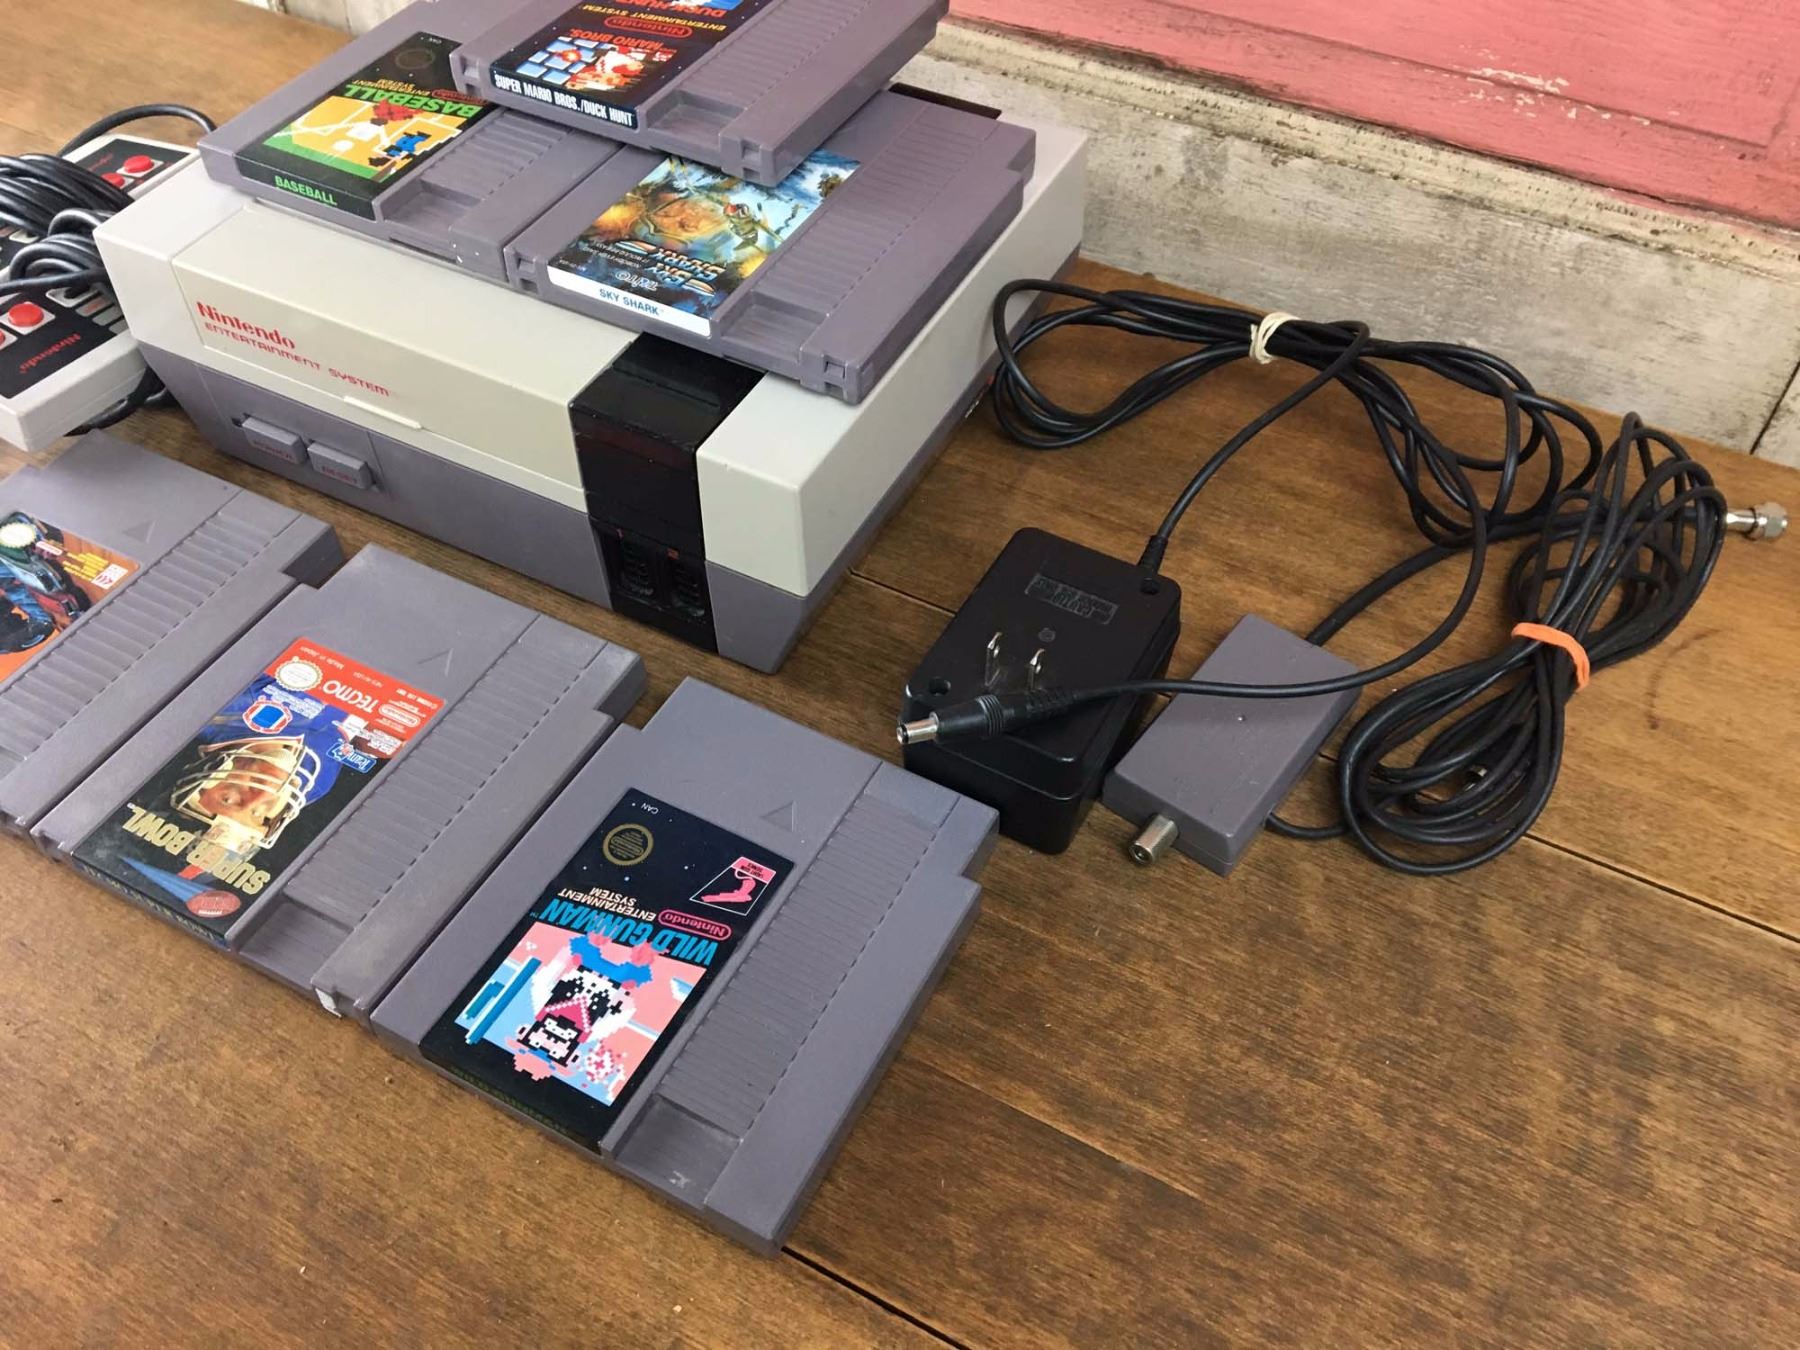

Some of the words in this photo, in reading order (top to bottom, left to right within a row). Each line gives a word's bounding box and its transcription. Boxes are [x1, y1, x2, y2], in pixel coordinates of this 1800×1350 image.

[582, 4, 629, 16] SYSTEM
[632, 11, 727, 31] ENTERTAINMENT
[570, 28, 613, 43] BROS.
[611, 17, 687, 35] Nintendo
[614, 35, 664, 49] MARIO
[352, 79, 431, 96] ENTERTAINMENT
[377, 78, 416, 90] SYSTEM
[345, 84, 483, 118] BASEBALL
[494, 74, 522, 93] SUPER
[523, 82, 553, 103] MARIO
[609, 107, 632, 127] HUNT
[275, 175, 338, 206] BASEBALL
[645, 262, 694, 289] SKY
[651, 248, 727, 281] SHARK
[599, 288, 620, 302] SKY
[623, 296, 660, 316] SHARK
[196, 301, 296, 349] Nintendo
[204, 322, 321, 370] ENTERTAINMENT
[328, 368, 390, 396] SYSTEM
[322, 679, 379, 713] TECMO
[640, 803, 659, 815] CAN
[122, 806, 197, 856] BOWL
[186, 840, 271, 895] SUPER
[558, 888, 656, 921] ENTERTAINMENT
[590, 886, 637, 906] SYSTEM
[540, 899, 654, 948] GUNMAN
[663, 912, 727, 937] Nintendo
[651, 929, 719, 966] WILD
